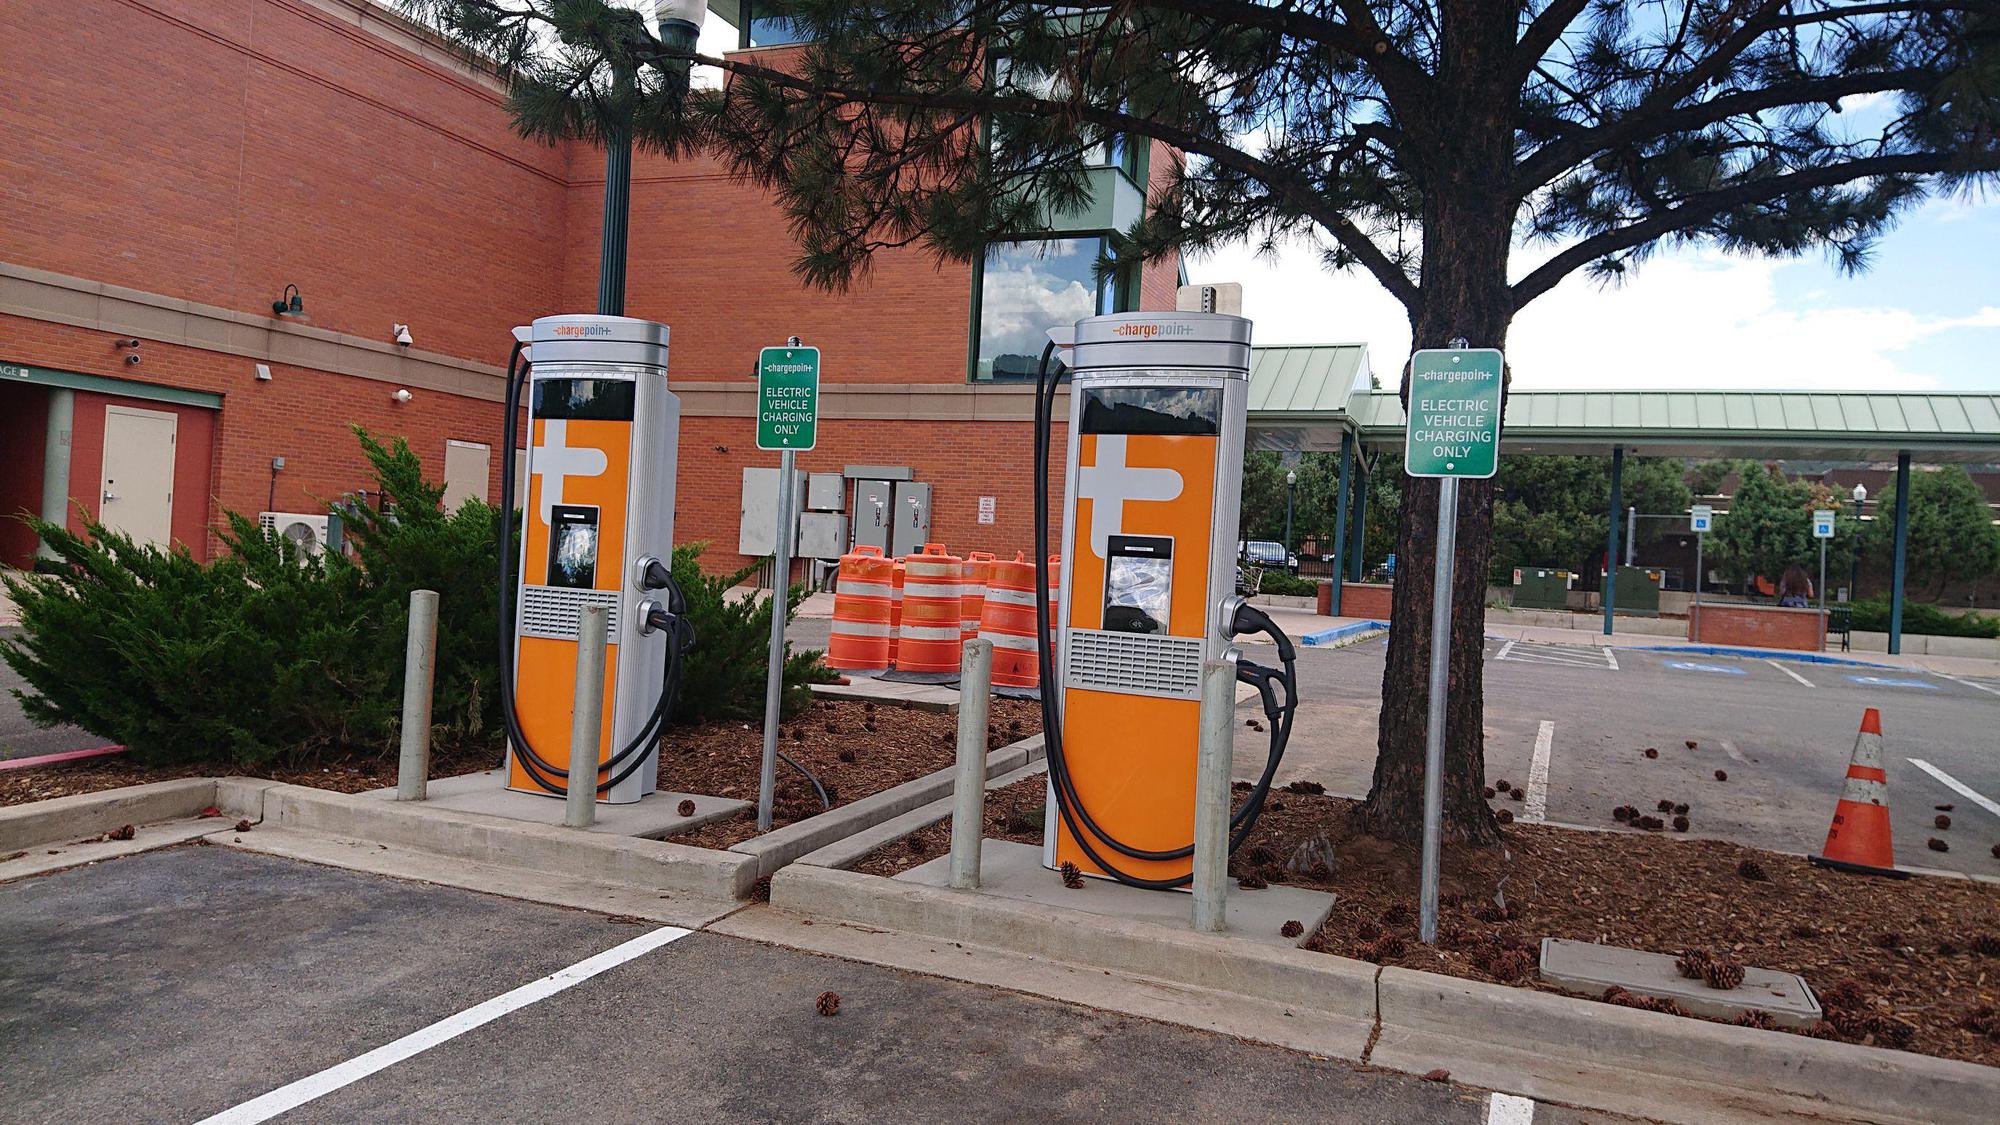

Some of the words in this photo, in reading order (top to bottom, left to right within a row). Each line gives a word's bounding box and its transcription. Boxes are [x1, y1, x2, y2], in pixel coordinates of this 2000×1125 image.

[766, 387, 811, 397] ELECTRIC
[768, 400, 808, 410] VEHICLE
[1421, 399, 1489, 411] ELECTRIC
[762, 412, 813, 422] CHARGING
[1424, 415, 1484, 427] VEHICLE
[774, 424, 800, 435] ONLY
[1415, 430, 1492, 443] CHARGING
[1432, 446, 1471, 458] ONLY
